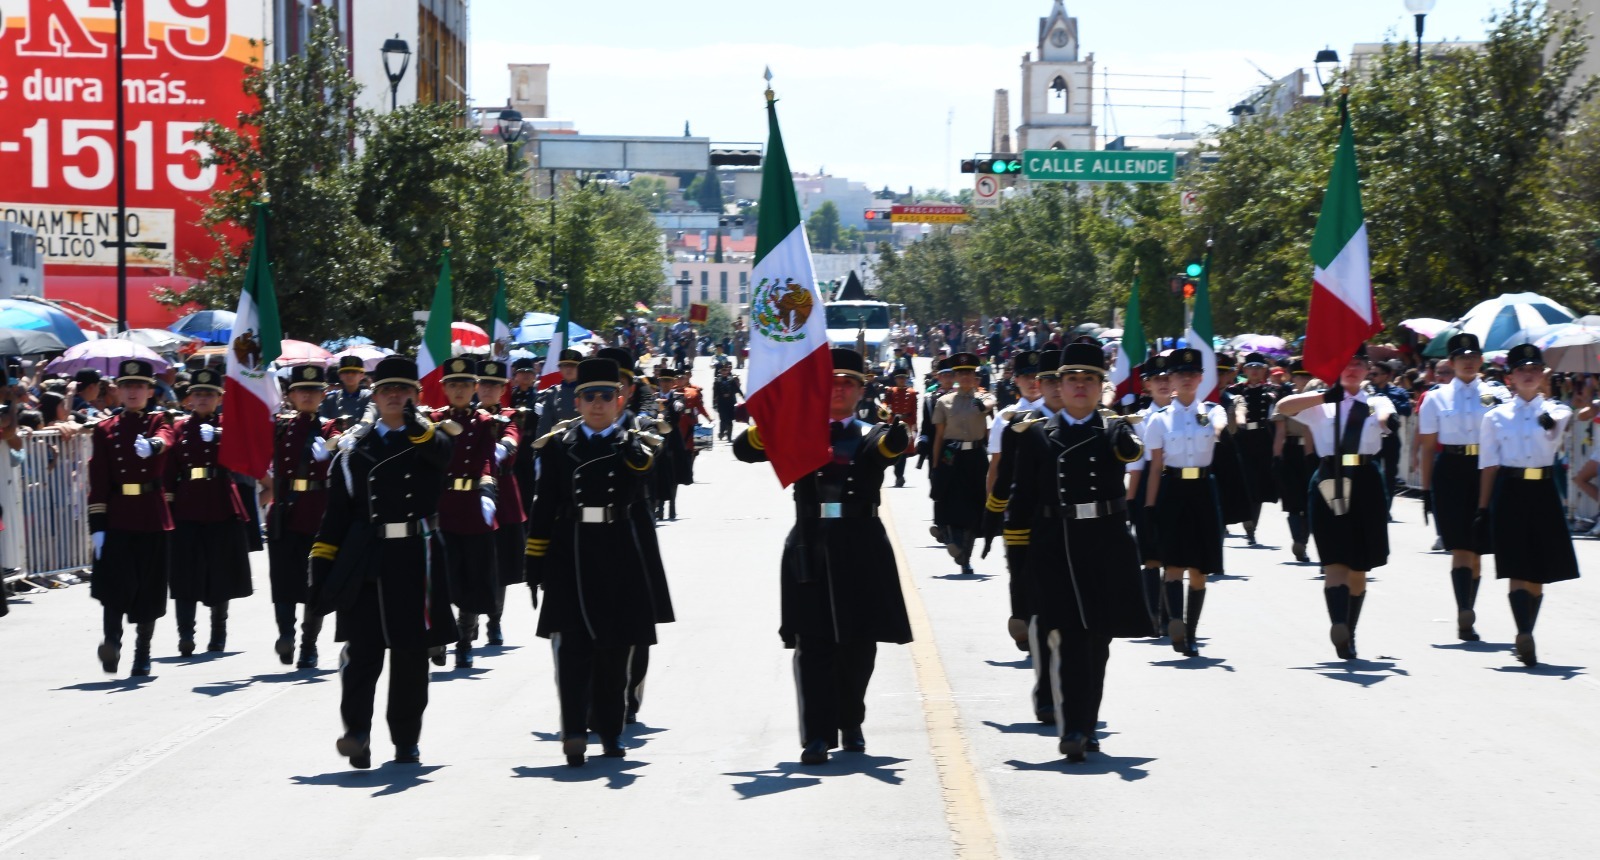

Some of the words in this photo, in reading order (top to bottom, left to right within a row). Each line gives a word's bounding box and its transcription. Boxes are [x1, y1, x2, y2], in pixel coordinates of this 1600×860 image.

[22, 68, 103, 102] dura
[1029, 158, 1085, 173] CALLE
[1091, 159, 1169, 174] ALLENDE
[0, 208, 140, 237] ONAMIENTO
[35, 236, 95, 258] BLICO
